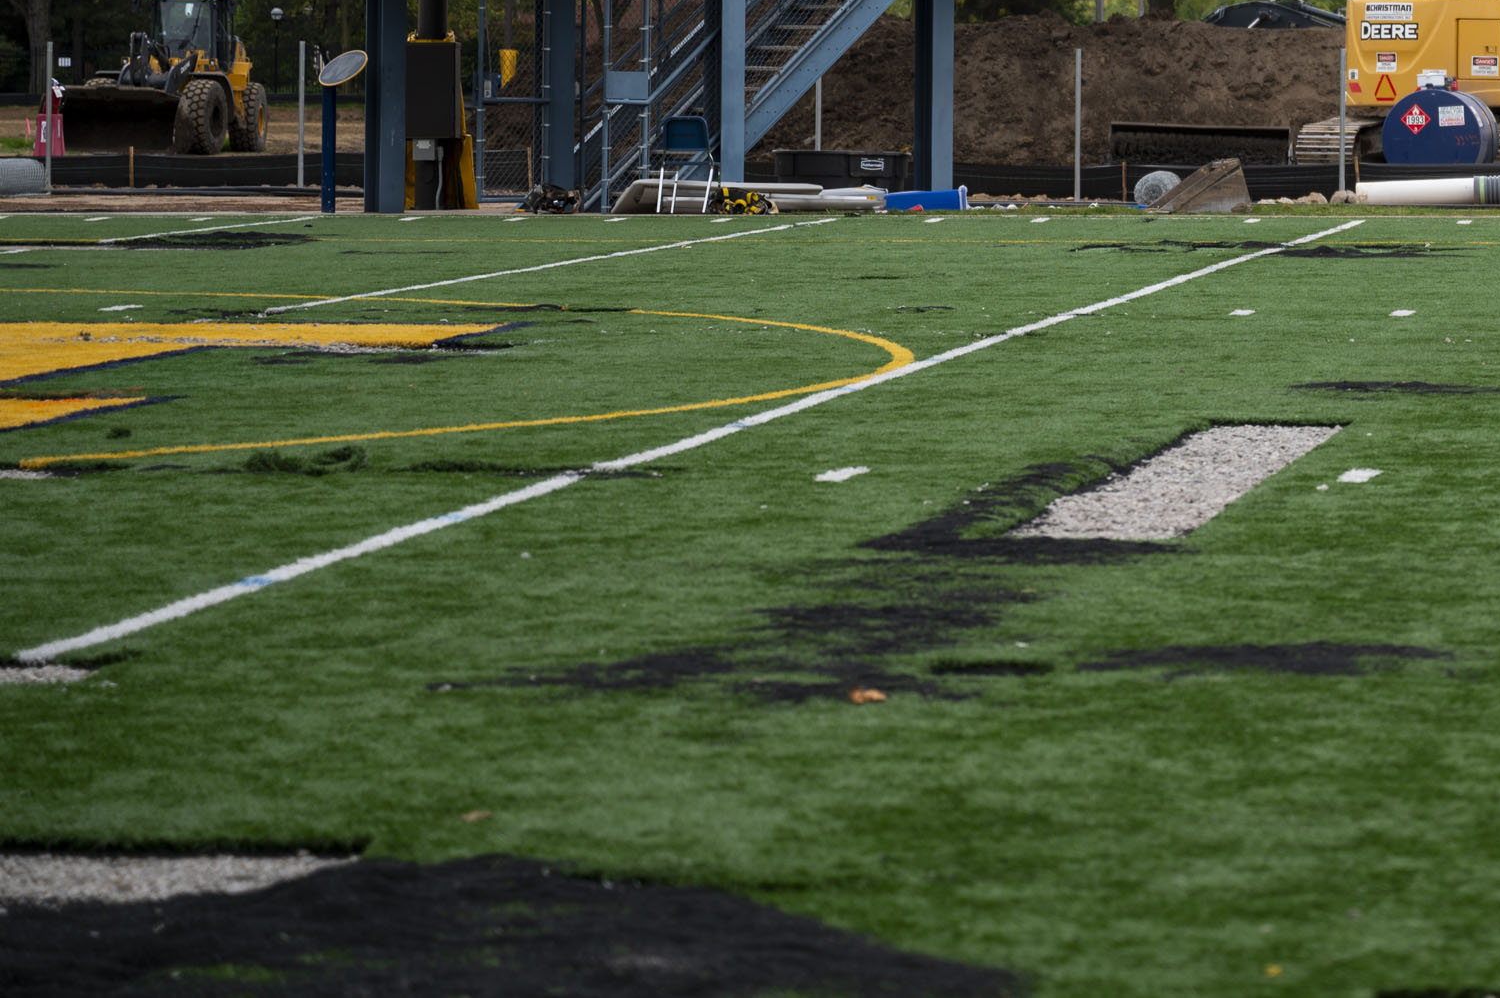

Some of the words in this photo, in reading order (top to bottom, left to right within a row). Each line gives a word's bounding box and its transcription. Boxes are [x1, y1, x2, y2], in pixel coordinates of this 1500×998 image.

[1370, 4, 1412, 12] CHRISTMAN
[1360, 21, 1419, 40] DEERE
[1406, 115, 1425, 125] 1993
